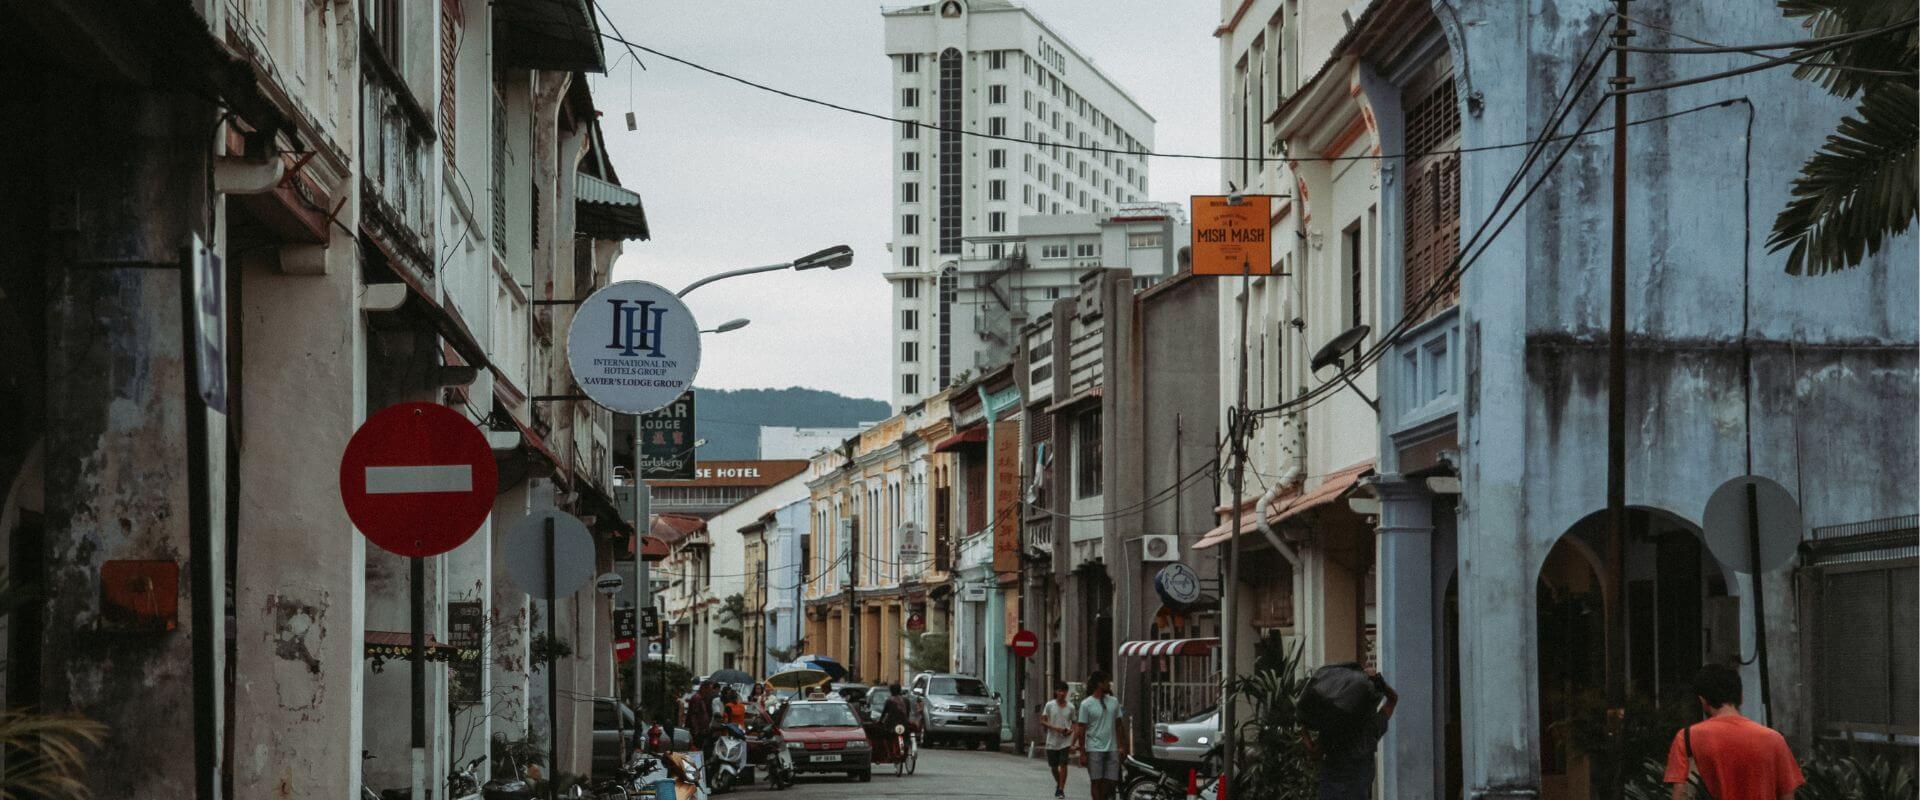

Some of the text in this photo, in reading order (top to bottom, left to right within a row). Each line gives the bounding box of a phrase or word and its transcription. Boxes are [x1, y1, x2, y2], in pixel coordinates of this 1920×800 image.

[1197, 228, 1265, 242] MISH MASH
[593, 359, 660, 368] INTERNATIONAL
[604, 367, 667, 376] HOTELS GROUP
[584, 377, 683, 388] XAVIER'S LODGE GROUP
[717, 468, 761, 477] HOTEL
